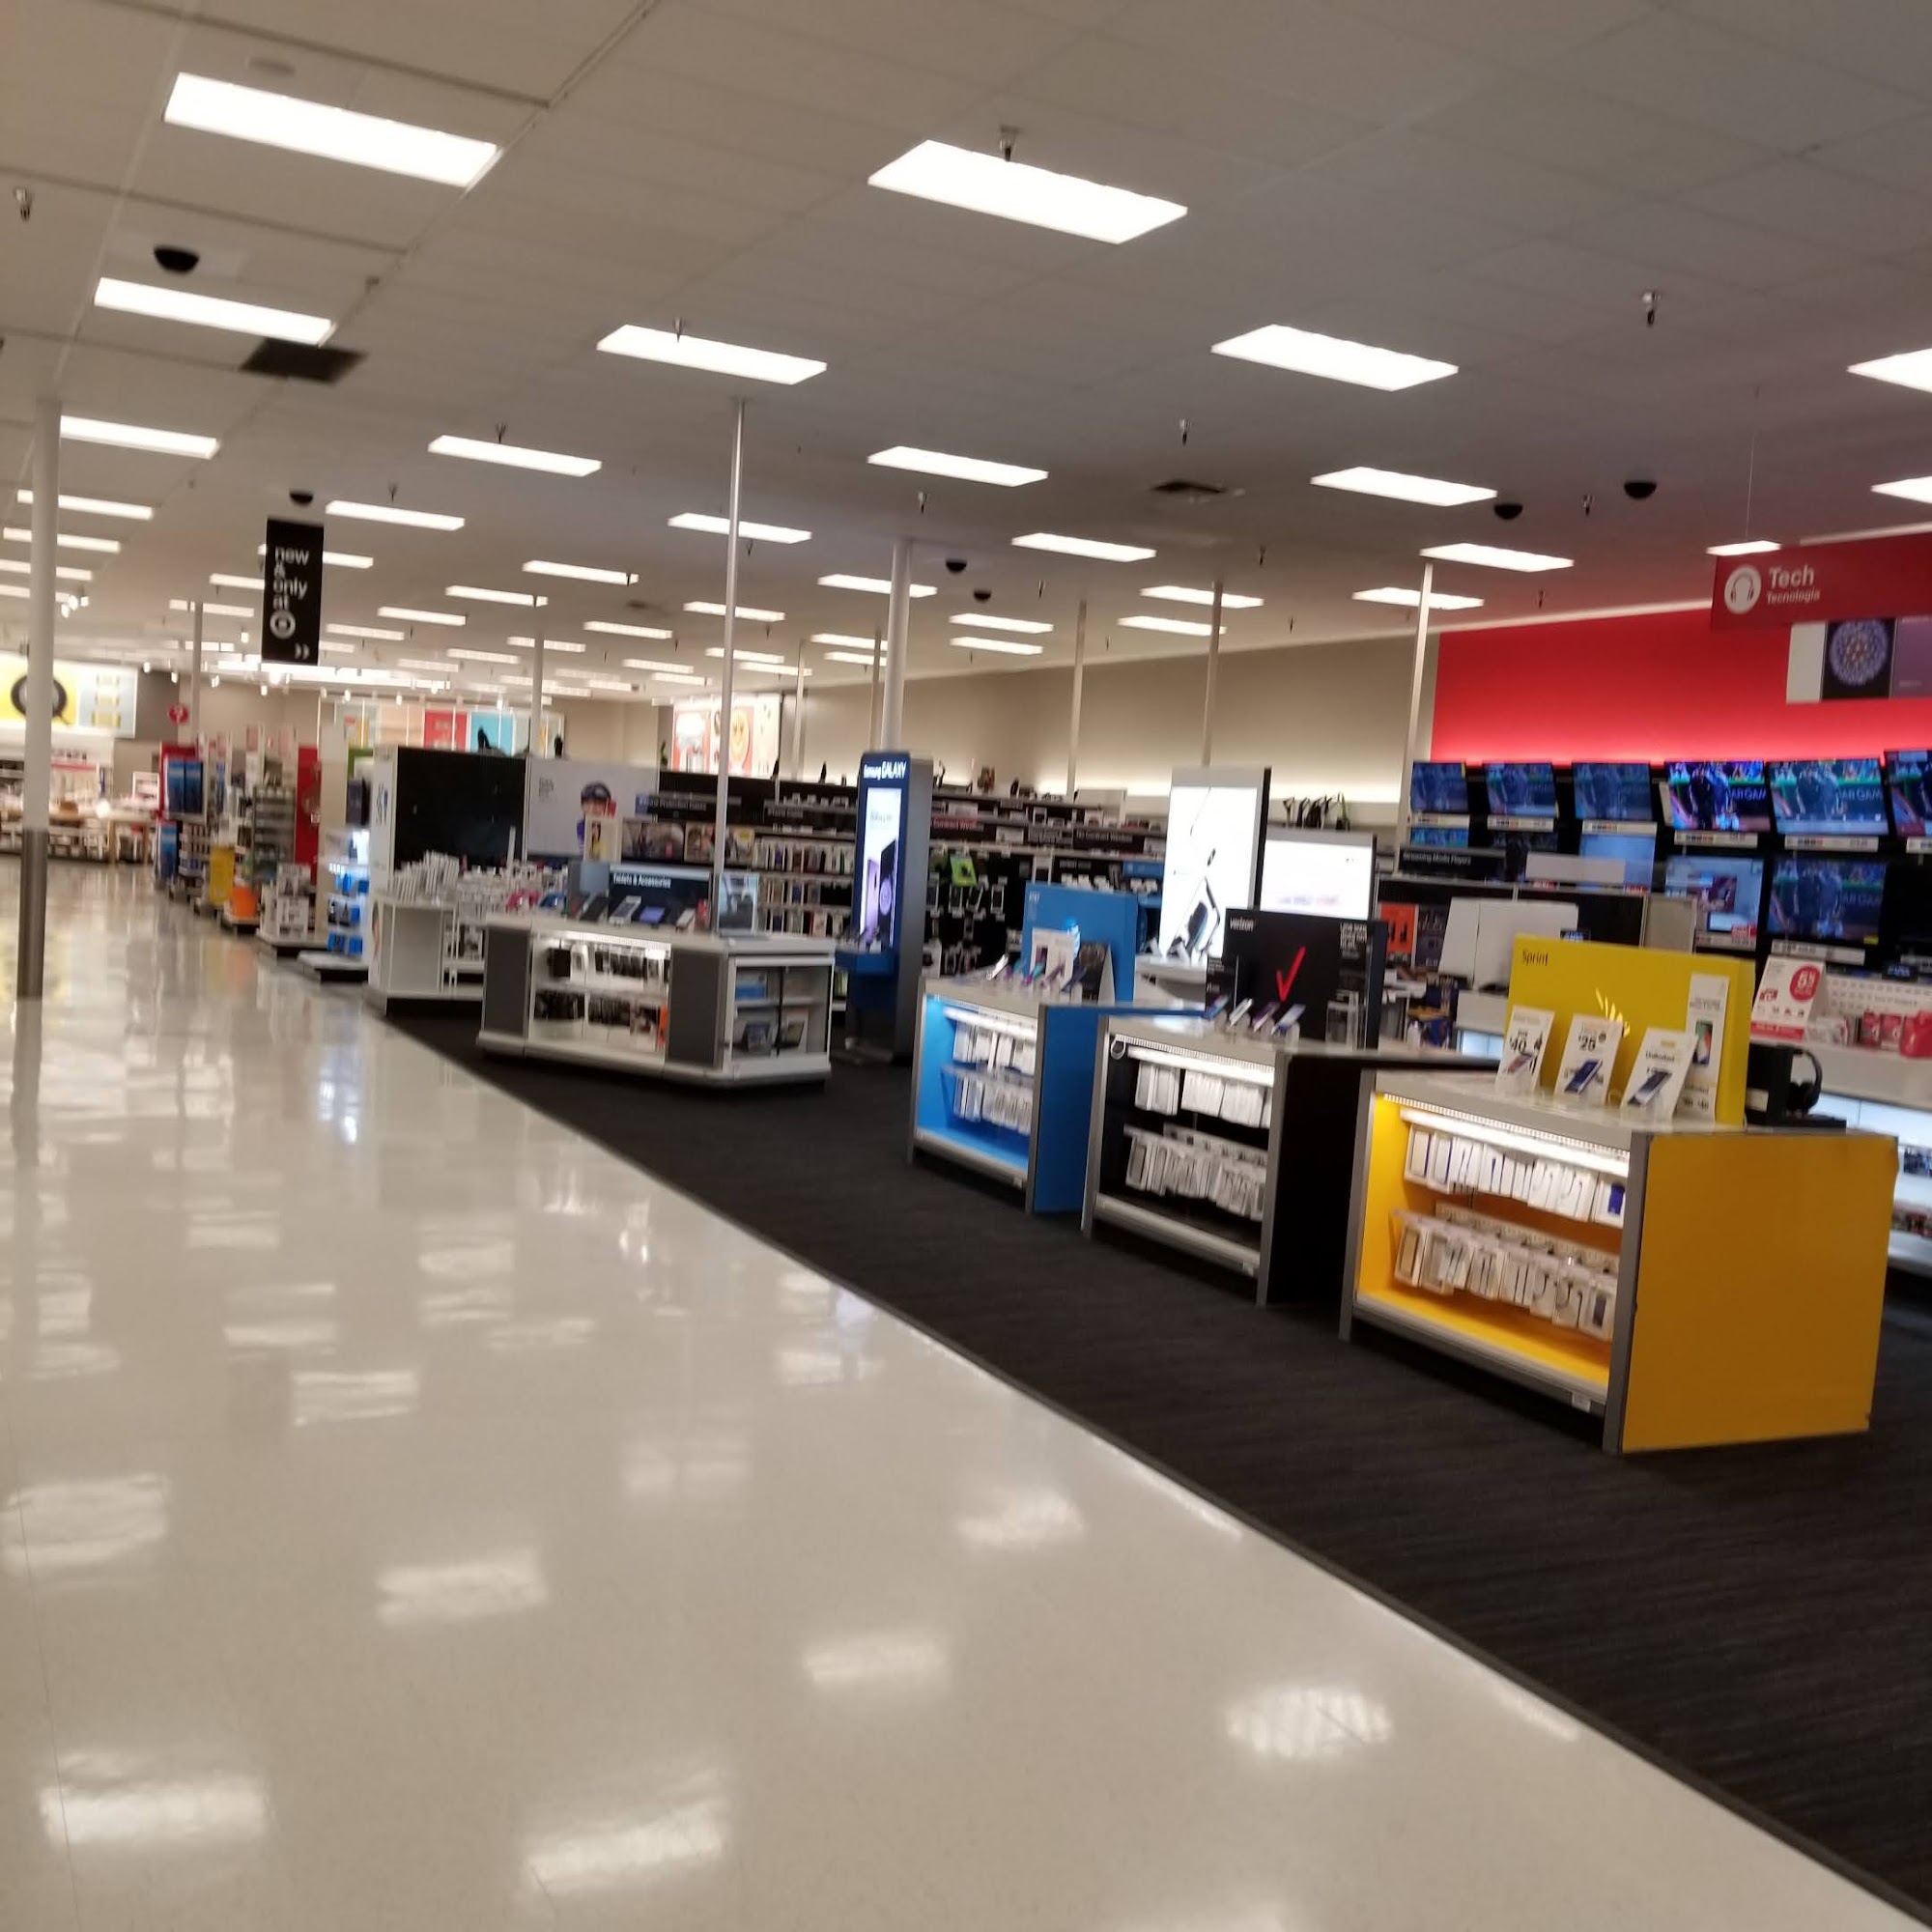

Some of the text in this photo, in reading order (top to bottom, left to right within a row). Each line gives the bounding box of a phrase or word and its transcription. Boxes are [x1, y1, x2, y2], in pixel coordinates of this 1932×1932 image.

[274, 546, 309, 566] new
[1769, 564, 1814, 589] Tech
[272, 577, 308, 600] only
[272, 594, 289, 611] at
[881, 760, 907, 780] GALAXY
[1230, 917, 1254, 932] verizon
[1522, 949, 1548, 966] Sprint
